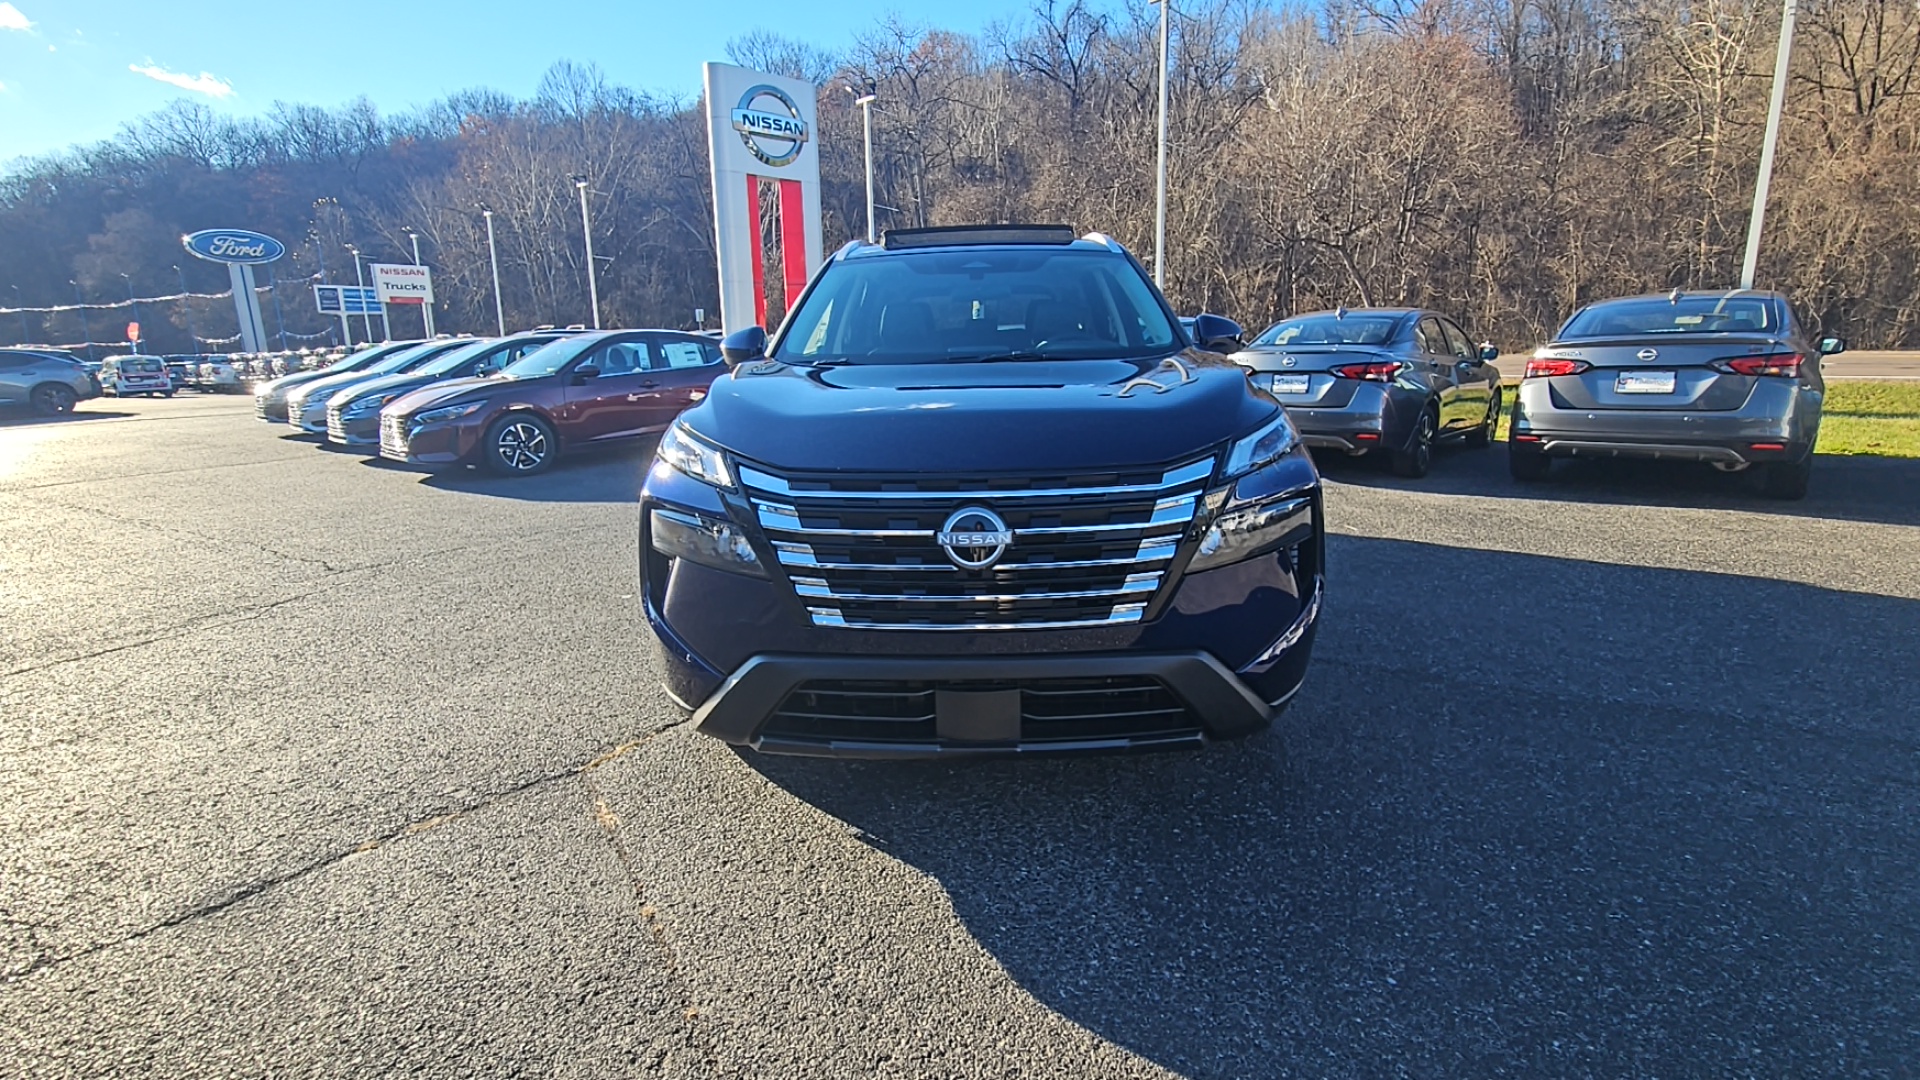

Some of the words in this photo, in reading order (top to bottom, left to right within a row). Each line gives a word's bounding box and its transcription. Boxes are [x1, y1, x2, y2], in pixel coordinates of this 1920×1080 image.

[741, 113, 804, 136] NISSAN
[209, 235, 265, 257] Ford
[380, 267, 425, 276] NISSAN
[383, 281, 427, 291] Trucks
[938, 534, 1009, 544] NISSAN
